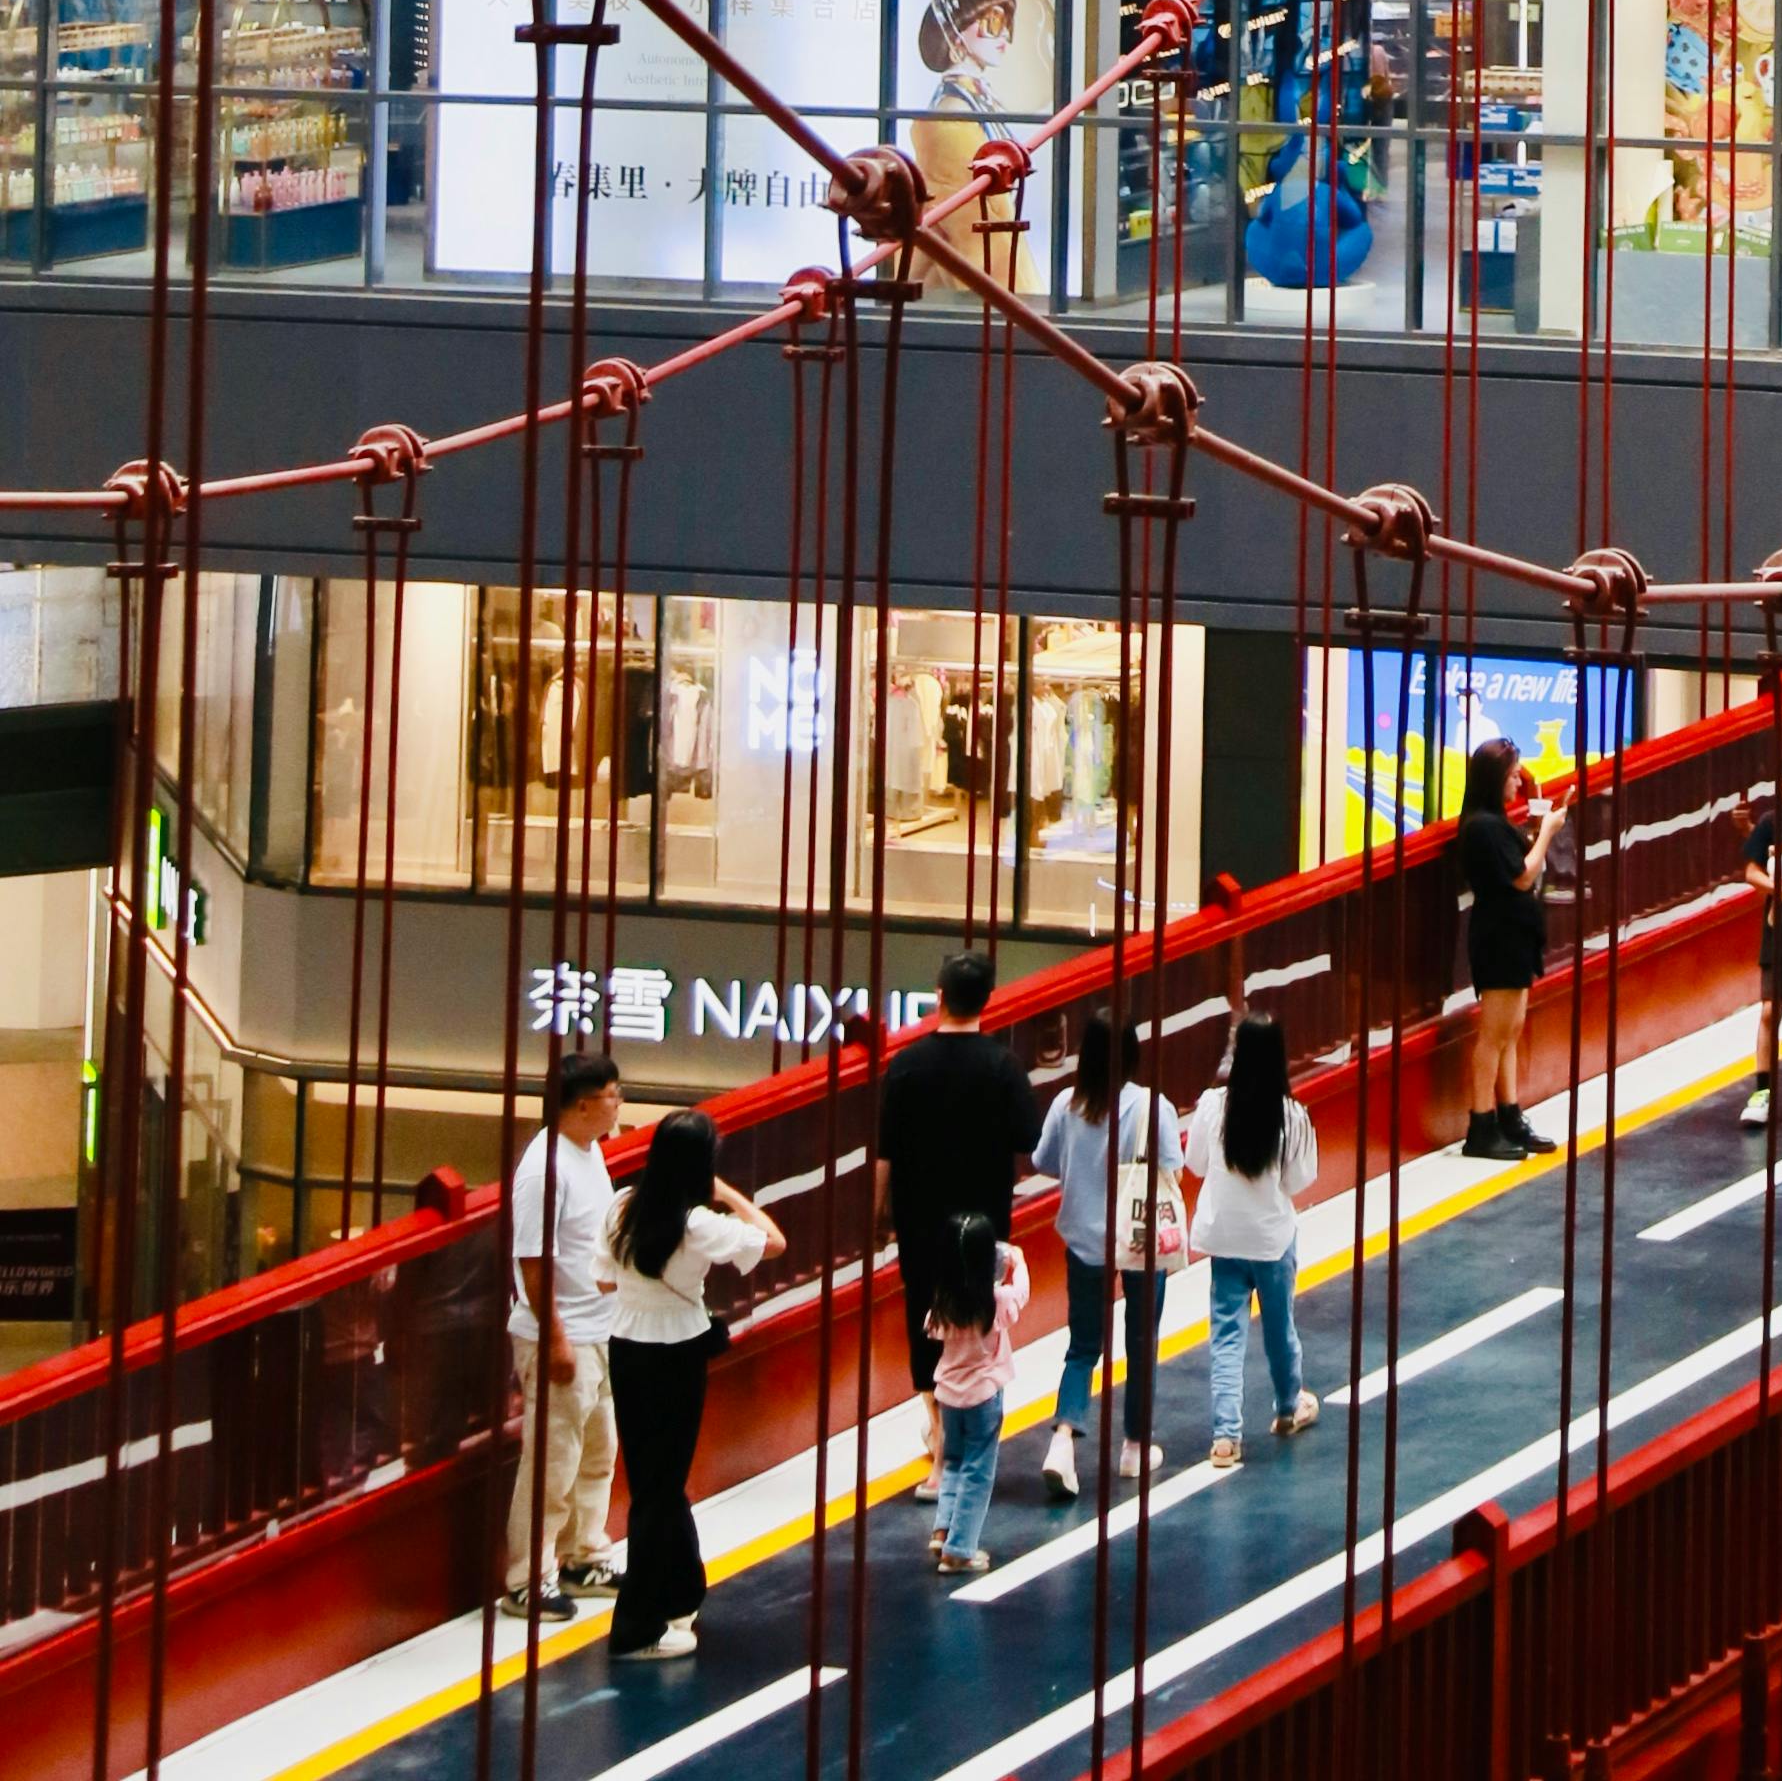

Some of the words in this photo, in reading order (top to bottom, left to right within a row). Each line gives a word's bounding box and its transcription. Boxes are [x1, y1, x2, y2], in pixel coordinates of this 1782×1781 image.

[1486, 673, 1504, 700] a
[1503, 674, 1554, 702] new
[529, 963, 673, 1043] 奈雪
